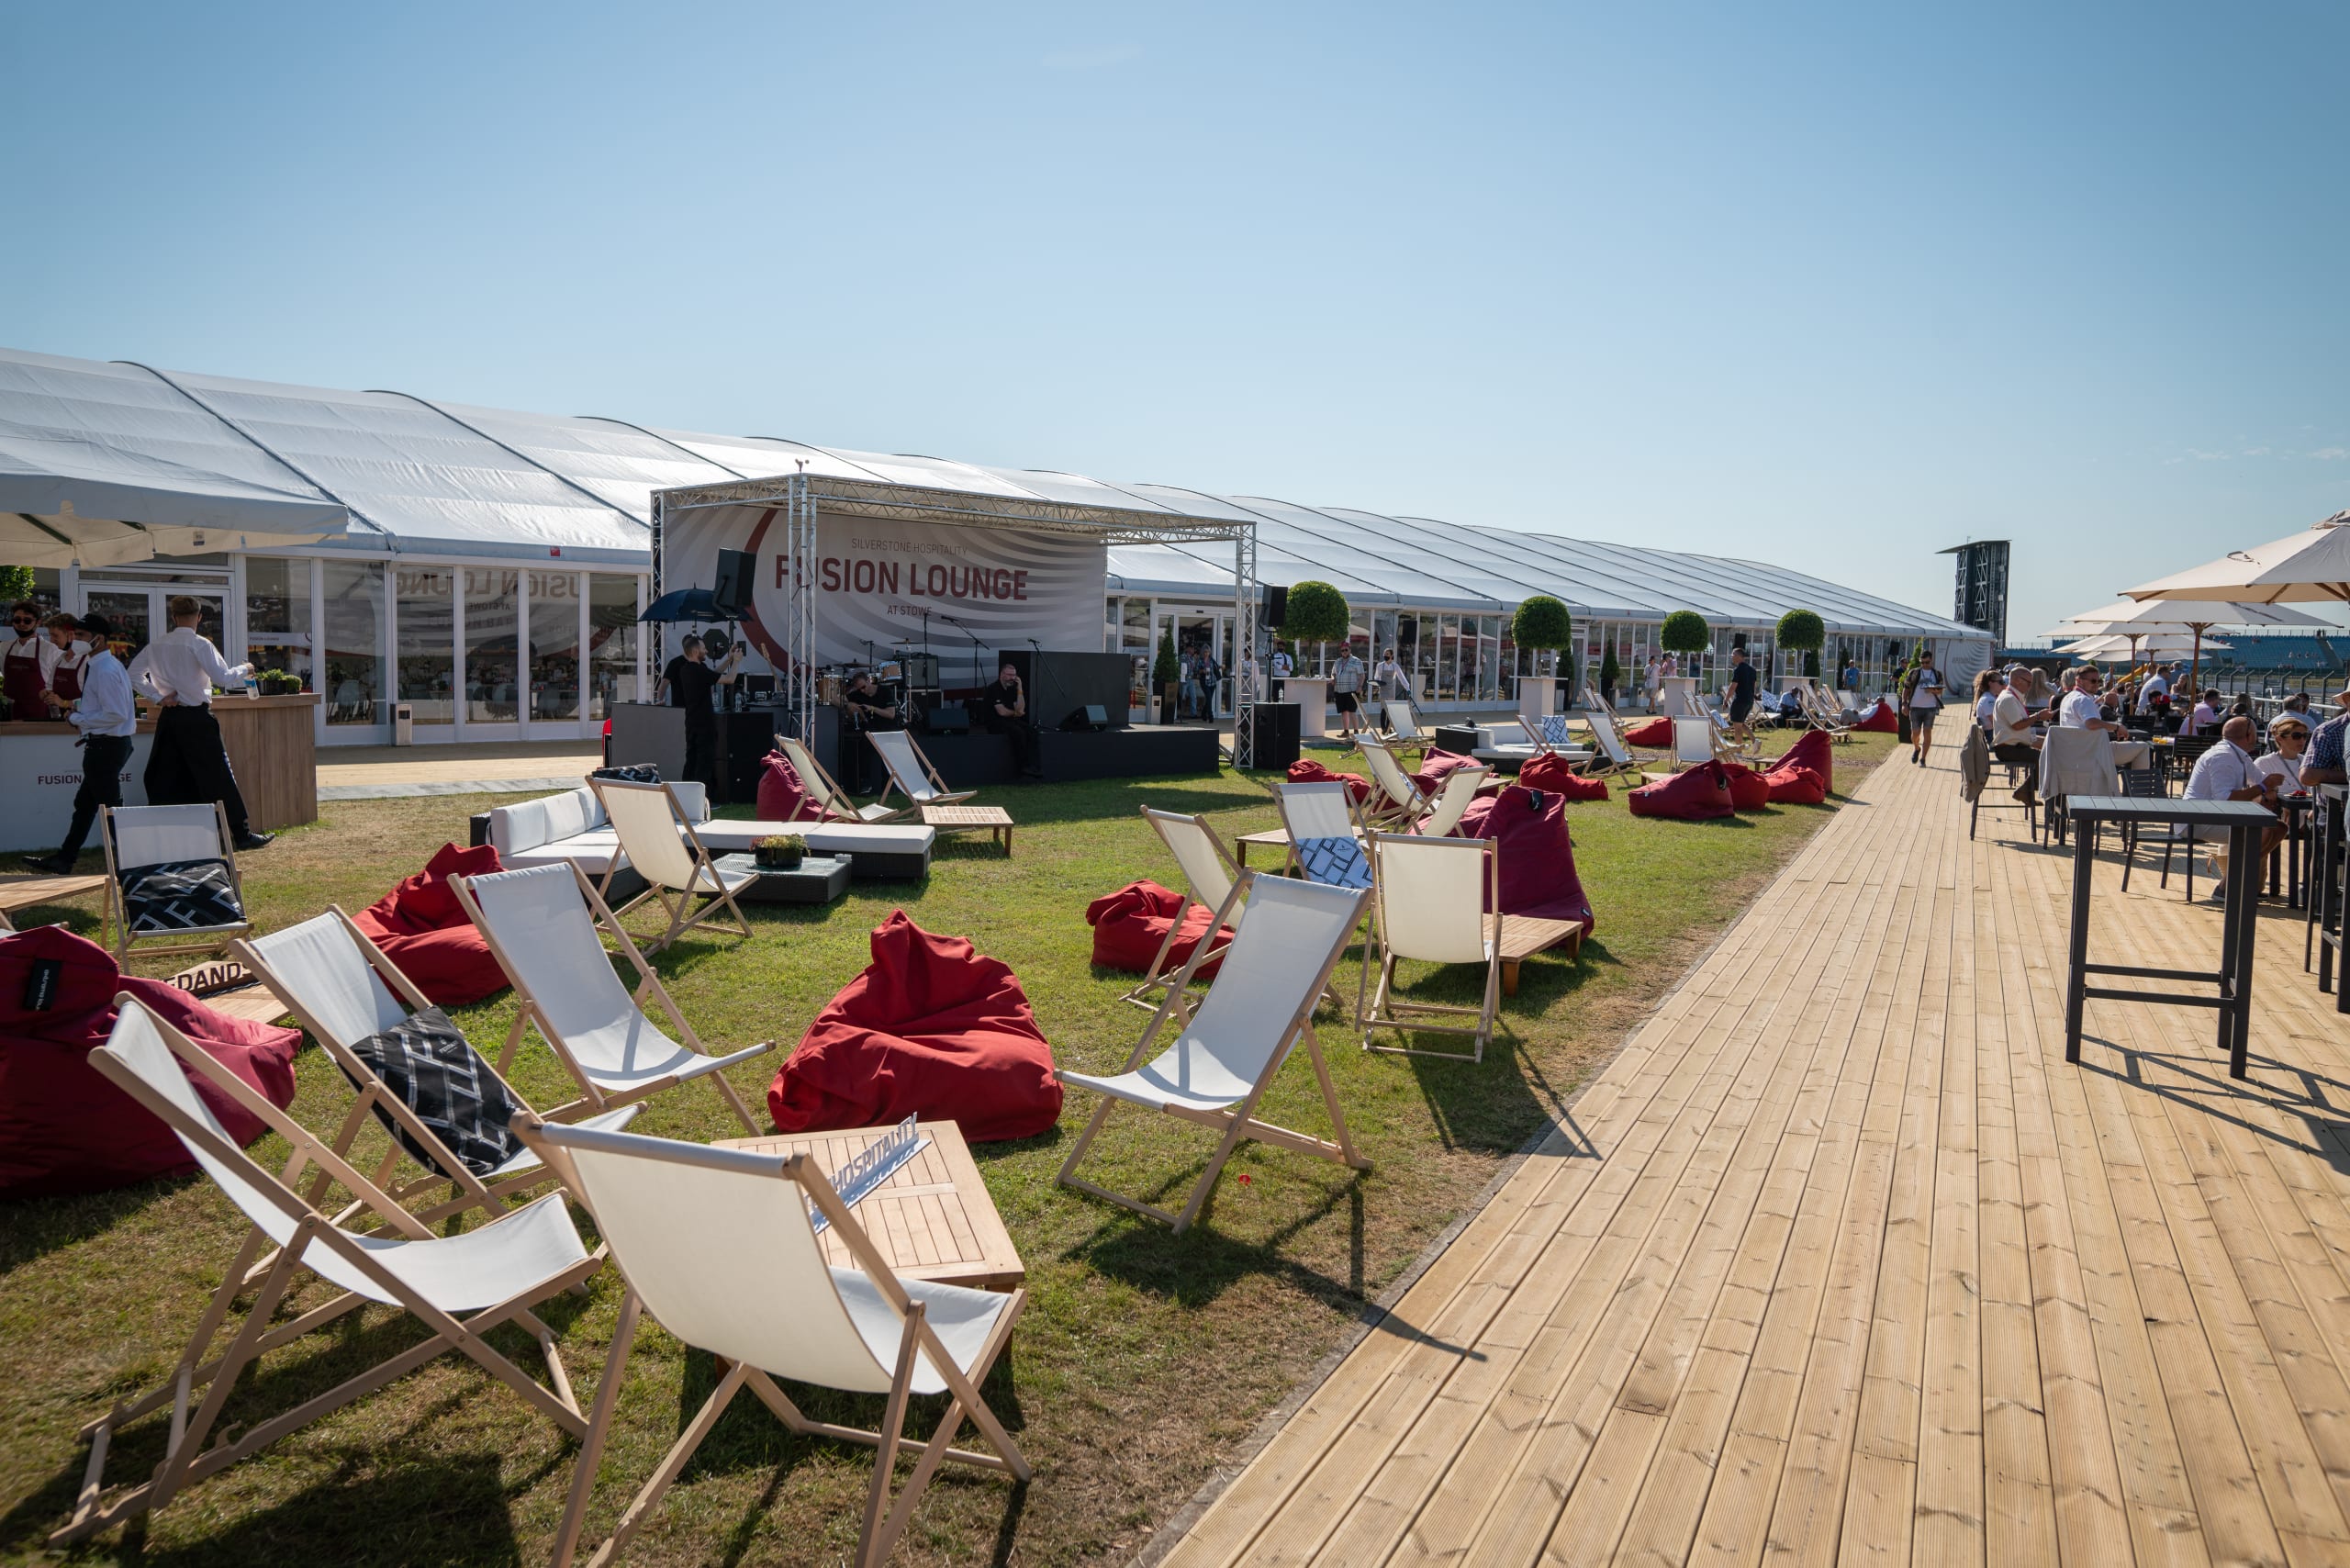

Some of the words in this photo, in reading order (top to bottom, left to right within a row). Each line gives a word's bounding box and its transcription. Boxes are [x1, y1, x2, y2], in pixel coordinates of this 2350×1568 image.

[851, 537, 912, 553] SILVERSTONE
[913, 543, 968, 555] HOSPITALITY
[775, 554, 900, 595] FUSION
[910, 563, 1028, 600] LOUNGE
[887, 604, 899, 615] AT
[900, 605, 933, 617] STOWE
[38, 774, 82, 785] FUSION
